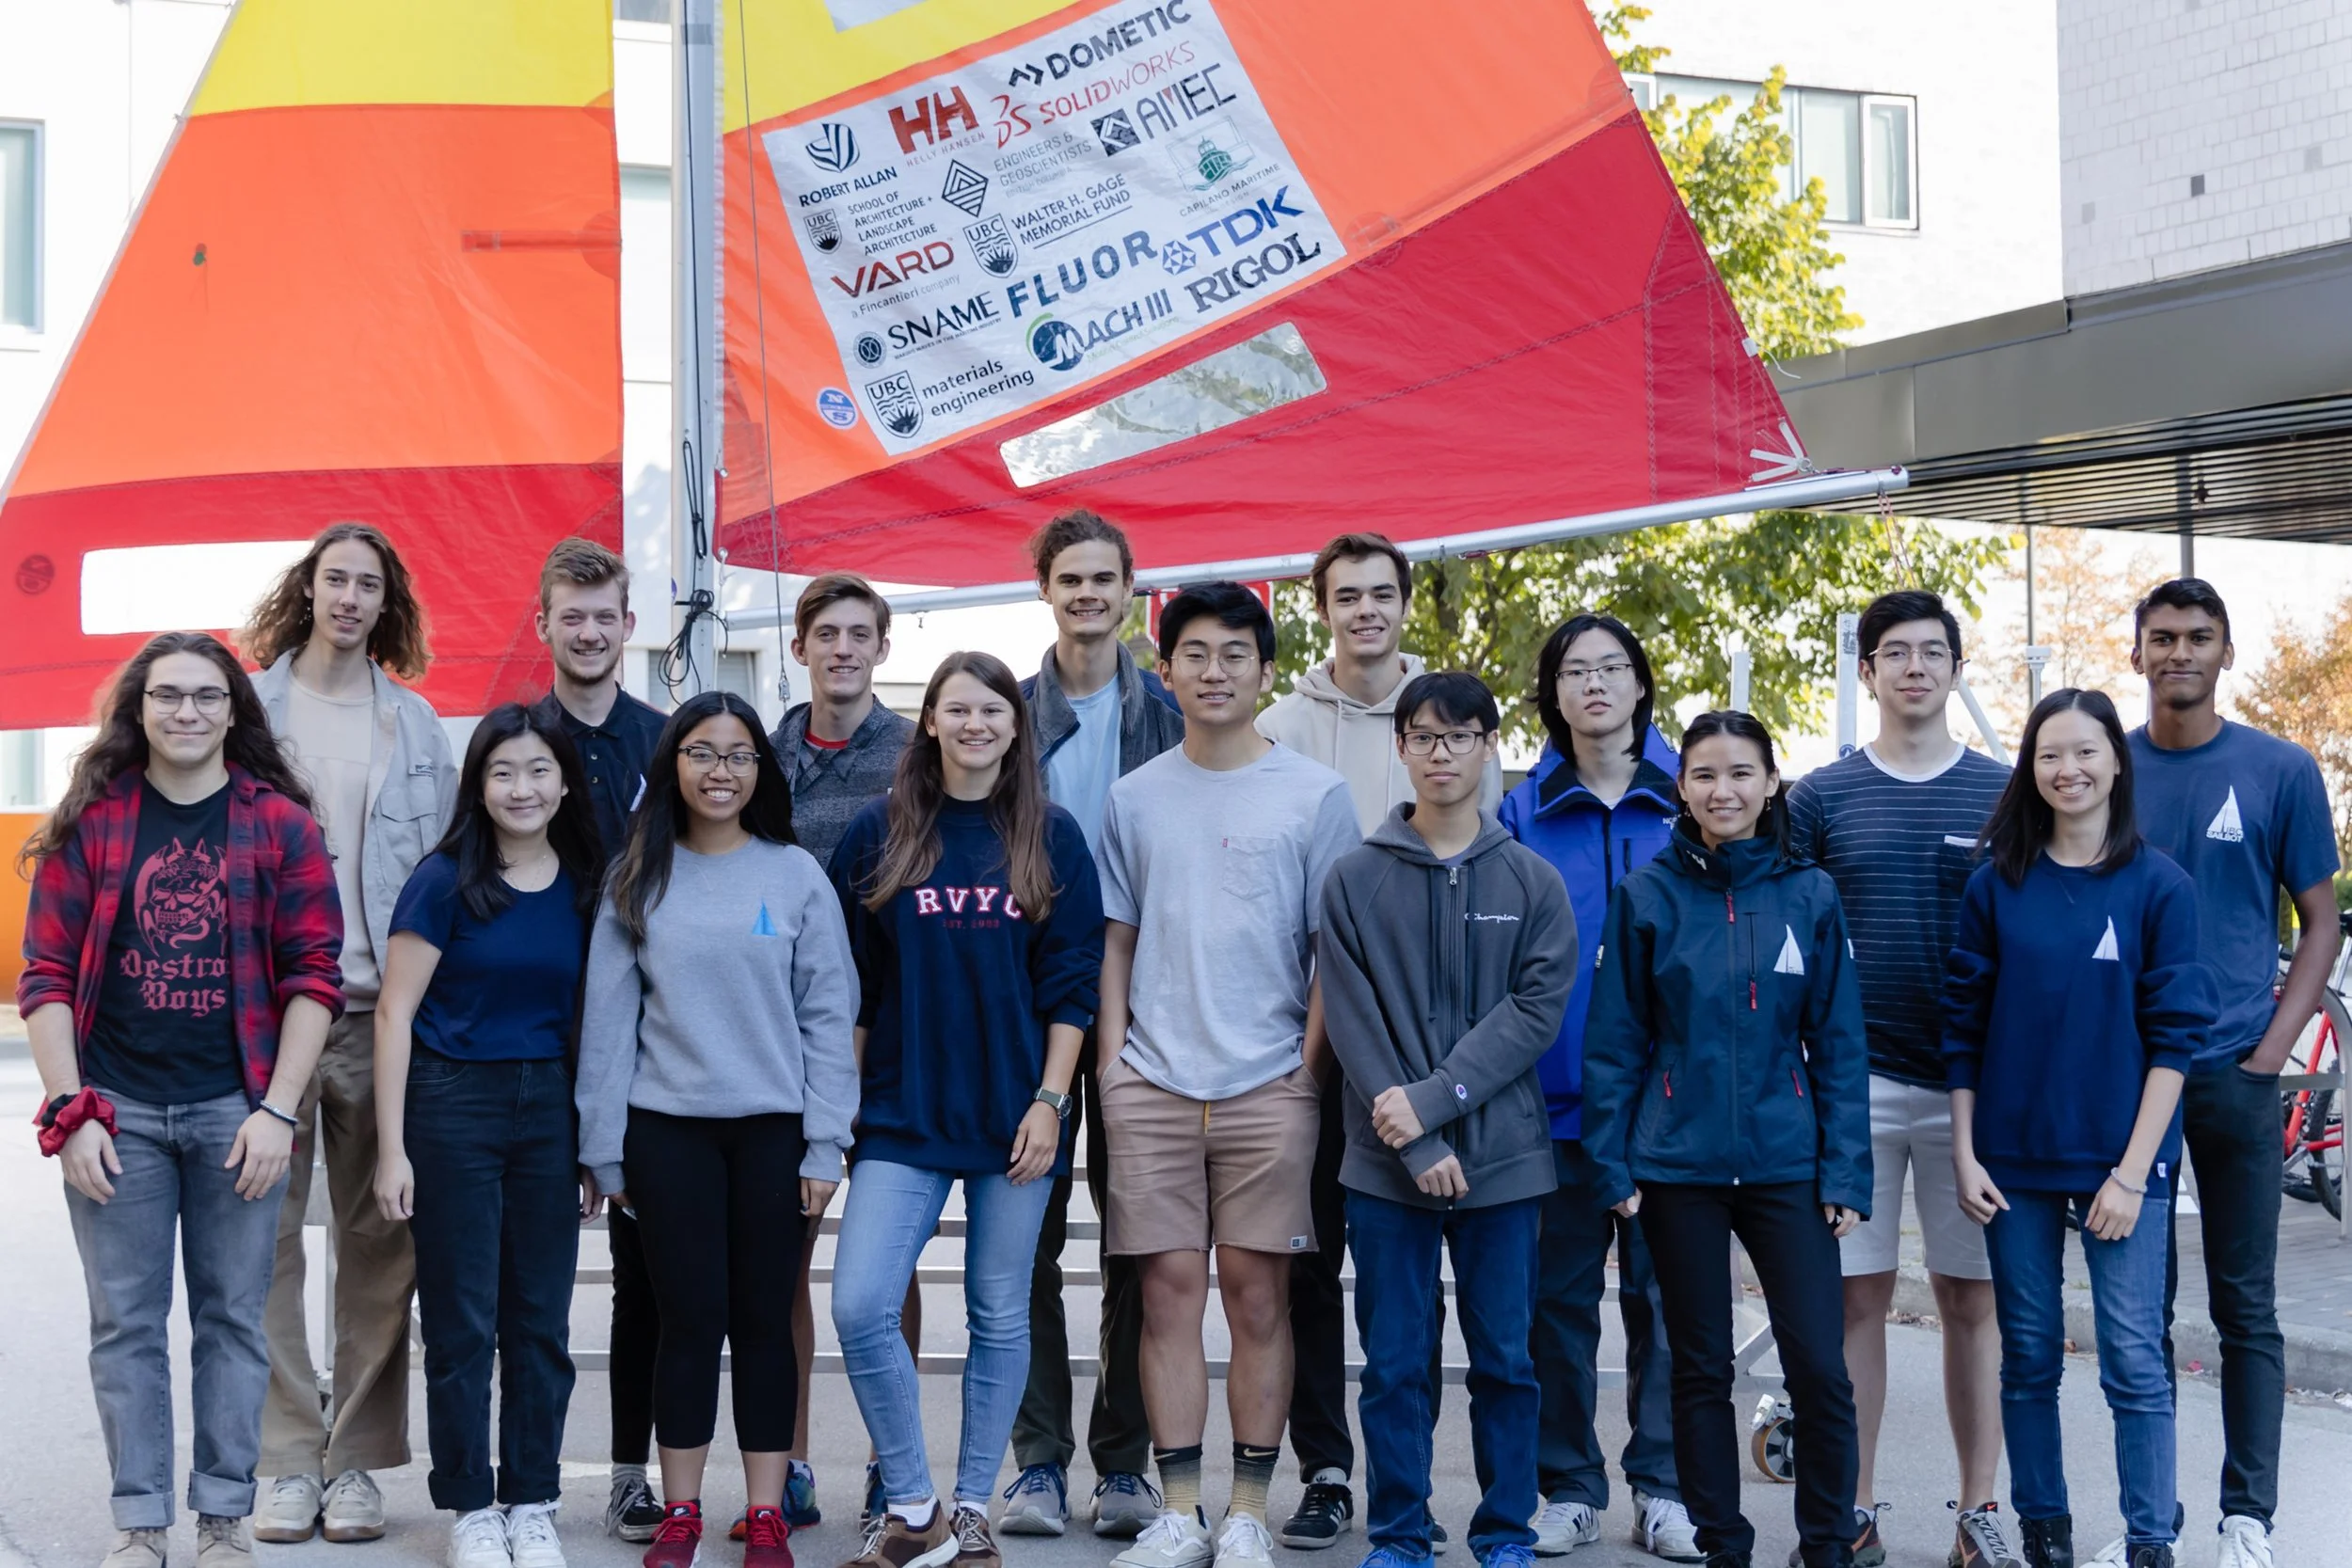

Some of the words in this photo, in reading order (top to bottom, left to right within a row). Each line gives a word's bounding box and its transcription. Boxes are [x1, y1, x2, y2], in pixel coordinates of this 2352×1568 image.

[1045, 0, 1192, 80] DOMETIC
[1039, 40, 1195, 125] SOLIDWORKS
[887, 86, 979, 155] HH
[906, 149, 937, 167] HELLY
[941, 132, 986, 154] HANSEN
[993, 136, 1061, 172] ENGINEERS
[1065, 132, 1073, 144] &
[1000, 140, 1092, 186] GEOSCIENTISTS
[799, 182, 850, 208] ROBERT
[853, 166, 898, 191] ALLAN
[848, 198, 884, 215] SCHOOL
[886, 191, 899, 203] OF
[1011, 199, 1068, 230] WALTER
[1068, 193, 1085, 206] H.
[1086, 173, 1126, 199] GAGE
[1180, 189, 1230, 217] CAPILANO
[1231, 163, 1280, 194] MARITIME
[807, 212, 834, 228] UBC
[854, 198, 925, 228] ARCHITECTURE
[858, 216, 914, 242] LANDSCAPE
[967, 218, 1003, 242] UBC
[1020, 206, 1092, 245] MEMORIAL
[1093, 189, 1131, 214] FUND
[1185, 184, 1305, 257] TDK
[864, 223, 937, 256] ARCHITECTURE
[831, 241, 954, 298] VARD
[920, 274, 961, 295] company
[1006, 230, 1158, 318] FLUOR
[1184, 232, 1321, 314] RIGOL
[887, 291, 1000, 350] SNAME
[870, 376, 910, 400] UBC
[922, 359, 1003, 400] materials
[931, 368, 1035, 417] engineering
[2206, 831, 2243, 843] SAILBOT
[119, 949, 230, 979] Destro
[138, 979, 226, 1018] Boys
